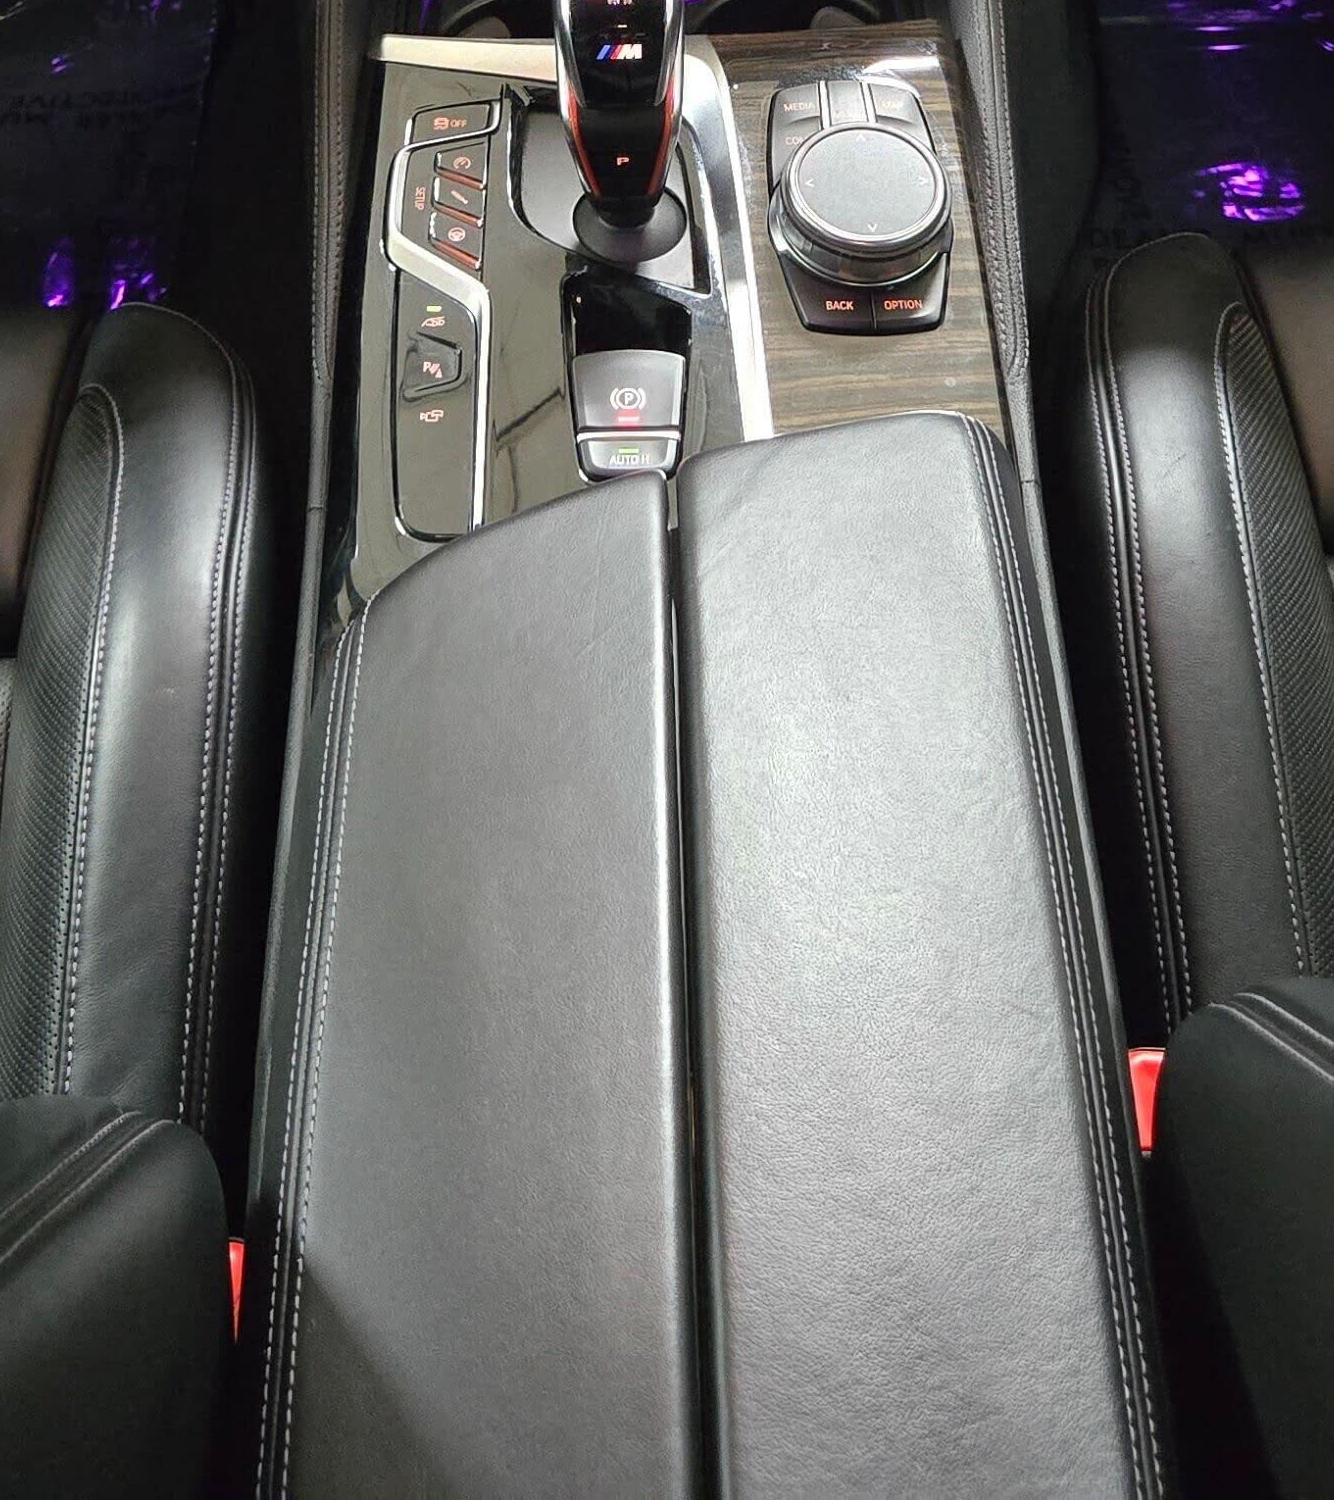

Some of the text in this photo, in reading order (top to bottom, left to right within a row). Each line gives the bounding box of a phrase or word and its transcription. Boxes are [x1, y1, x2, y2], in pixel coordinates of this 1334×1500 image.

[783, 101, 815, 113] MEDIA
[450, 118, 467, 129] OFF
[616, 156, 630, 166] P
[825, 299, 855, 311] BACK
[883, 299, 924, 311] OPTION
[609, 454, 651, 465] AUTO H
